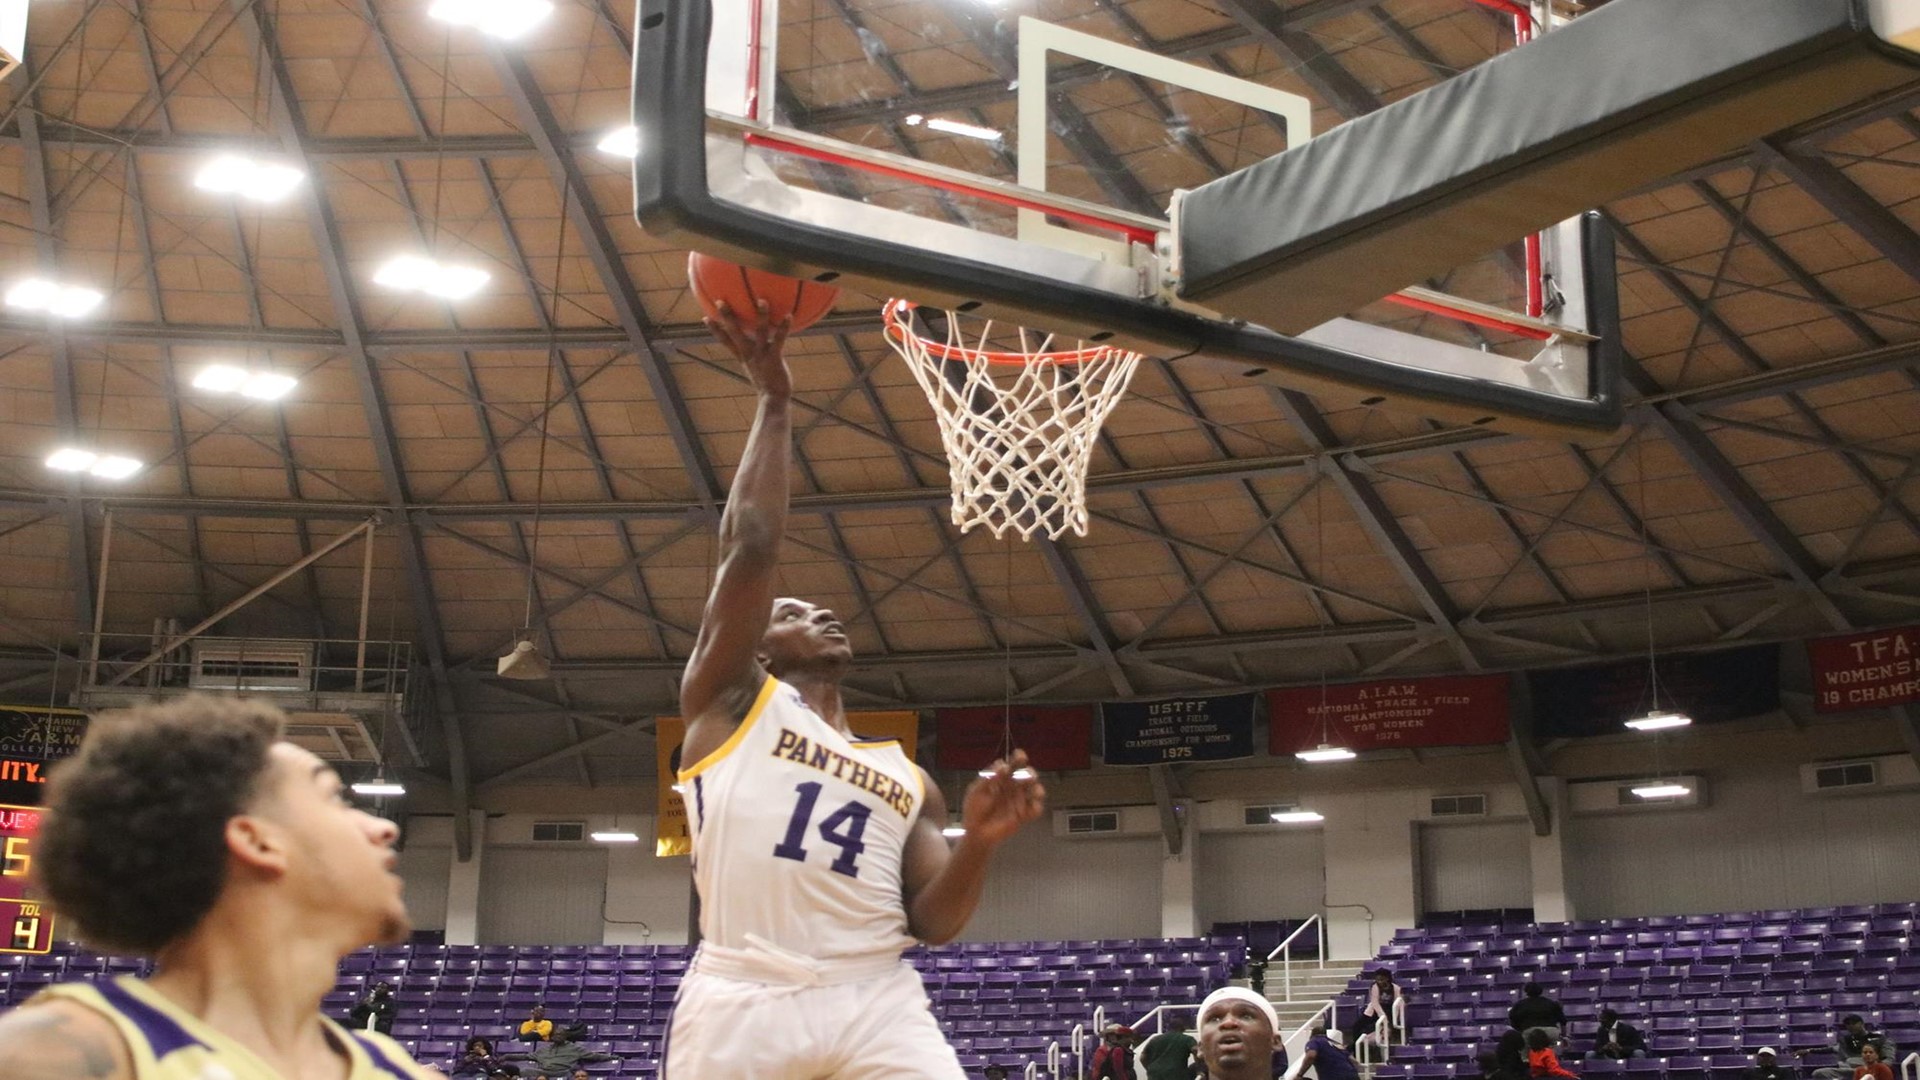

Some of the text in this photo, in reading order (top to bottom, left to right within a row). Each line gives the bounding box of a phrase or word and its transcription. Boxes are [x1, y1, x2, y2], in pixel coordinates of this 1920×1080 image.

[1824, 661, 1911, 685] WOMEN'S
[1823, 690, 1841, 705] 19
[1149, 701, 1208, 715] USTFF
[1307, 702, 1368, 715] NATIONAL
[1375, 698, 1418, 709] TRACK
[1434, 696, 1471, 705] FIELD
[1148, 715, 1173, 726] TRACK
[1186, 714, 1209, 723] FIELD
[1344, 708, 1434, 722] CHAMPIONSHIP
[44, 725, 75, 733] VIEW
[1139, 724, 1218, 737] NATIONAL OUTDOORS
[1353, 719, 1425, 733] FOR WOMEN
[29, 732, 81, 745] A & M
[1125, 734, 1231, 749] CHAMPIONSHIP FOR WOMEN
[1162, 746, 1193, 759] 1975
[772, 728, 914, 818] PANTHERS
[773, 781, 873, 878] 14
[20, 903, 41, 916] TOL
[14, 918, 39, 949] 4
